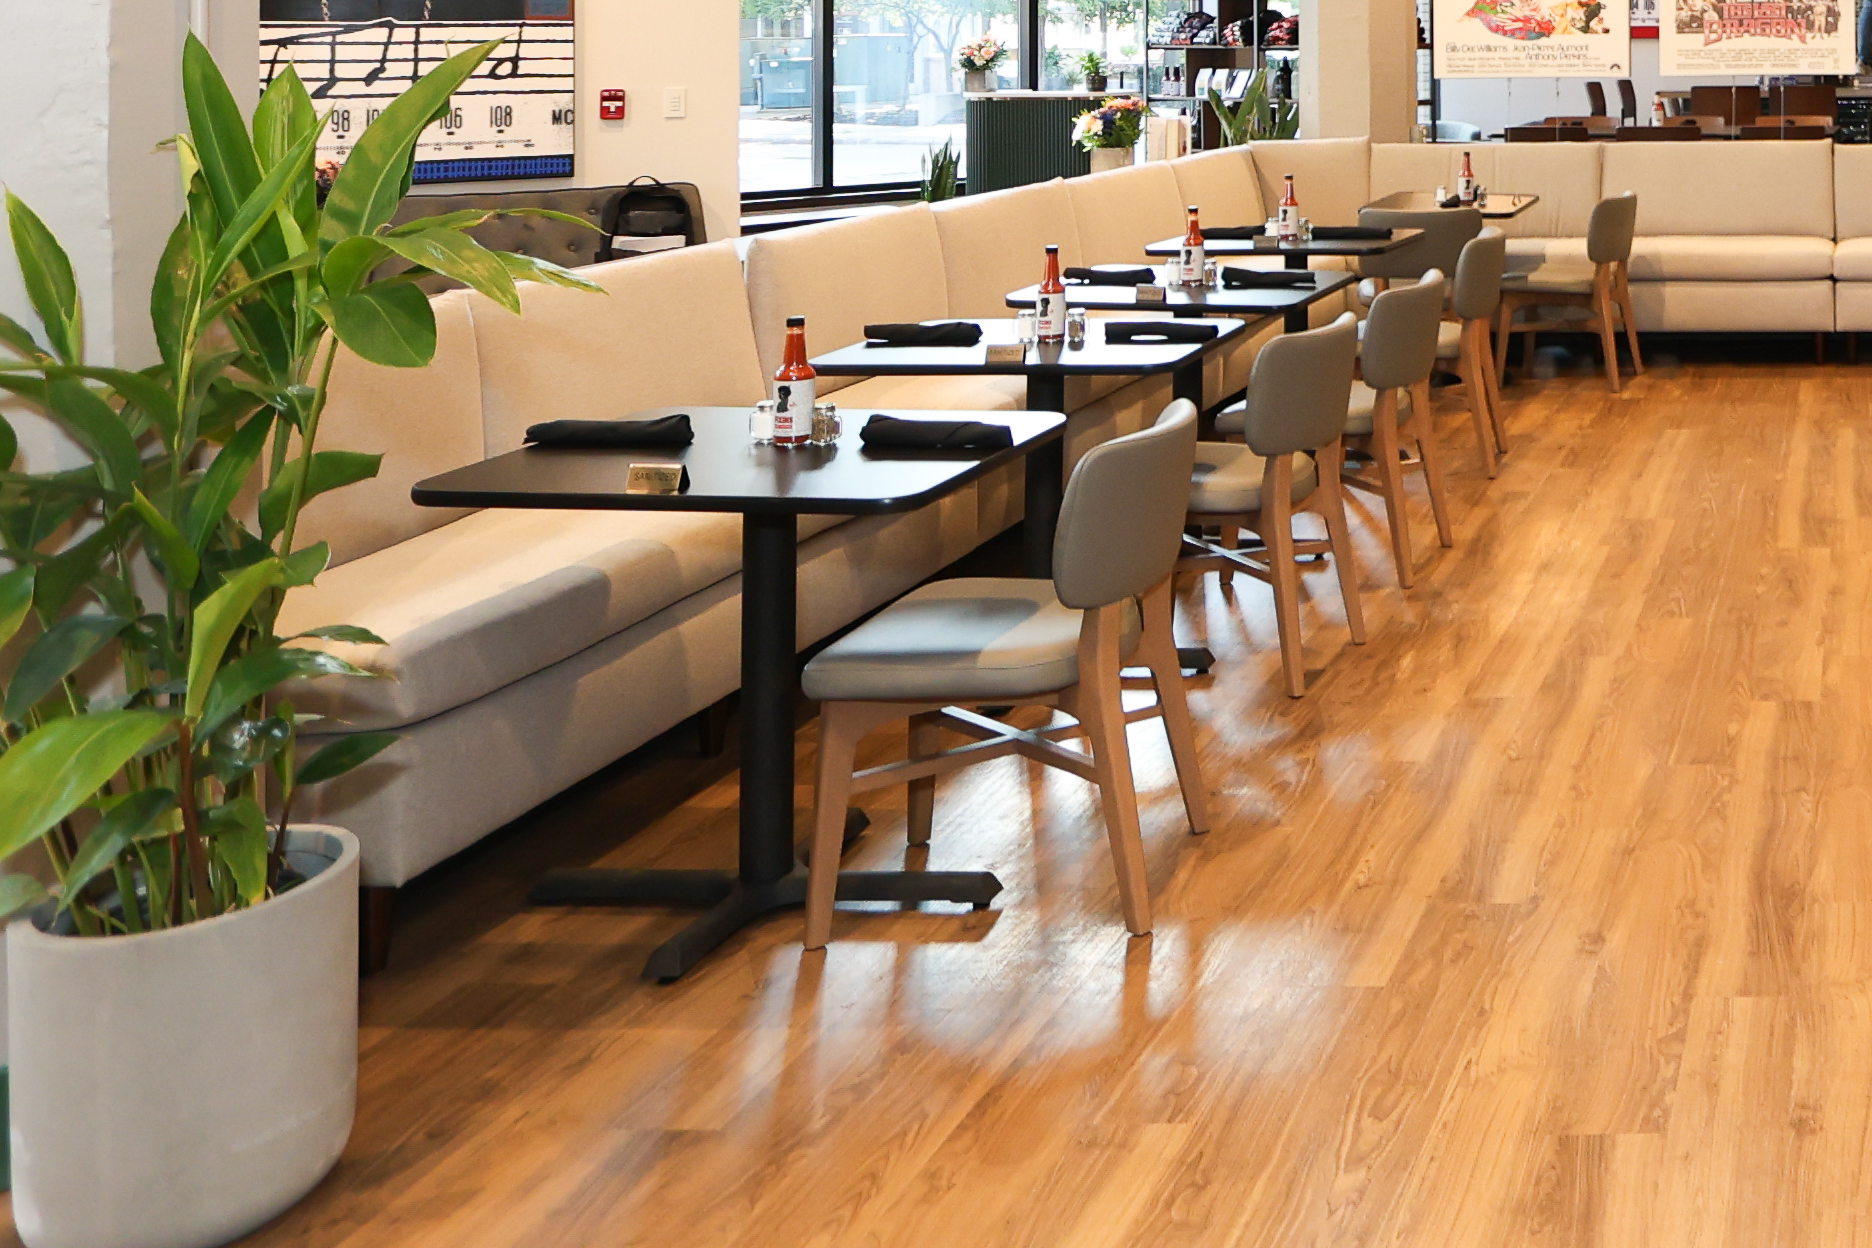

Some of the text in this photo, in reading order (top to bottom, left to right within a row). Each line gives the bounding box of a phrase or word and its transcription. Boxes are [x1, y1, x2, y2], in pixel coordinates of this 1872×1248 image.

[1720, 2, 1788, 19] THE LAST
[1703, 18, 1807, 47] DRAGON
[331, 109, 351, 133] 98
[490, 105, 513, 128] 108
